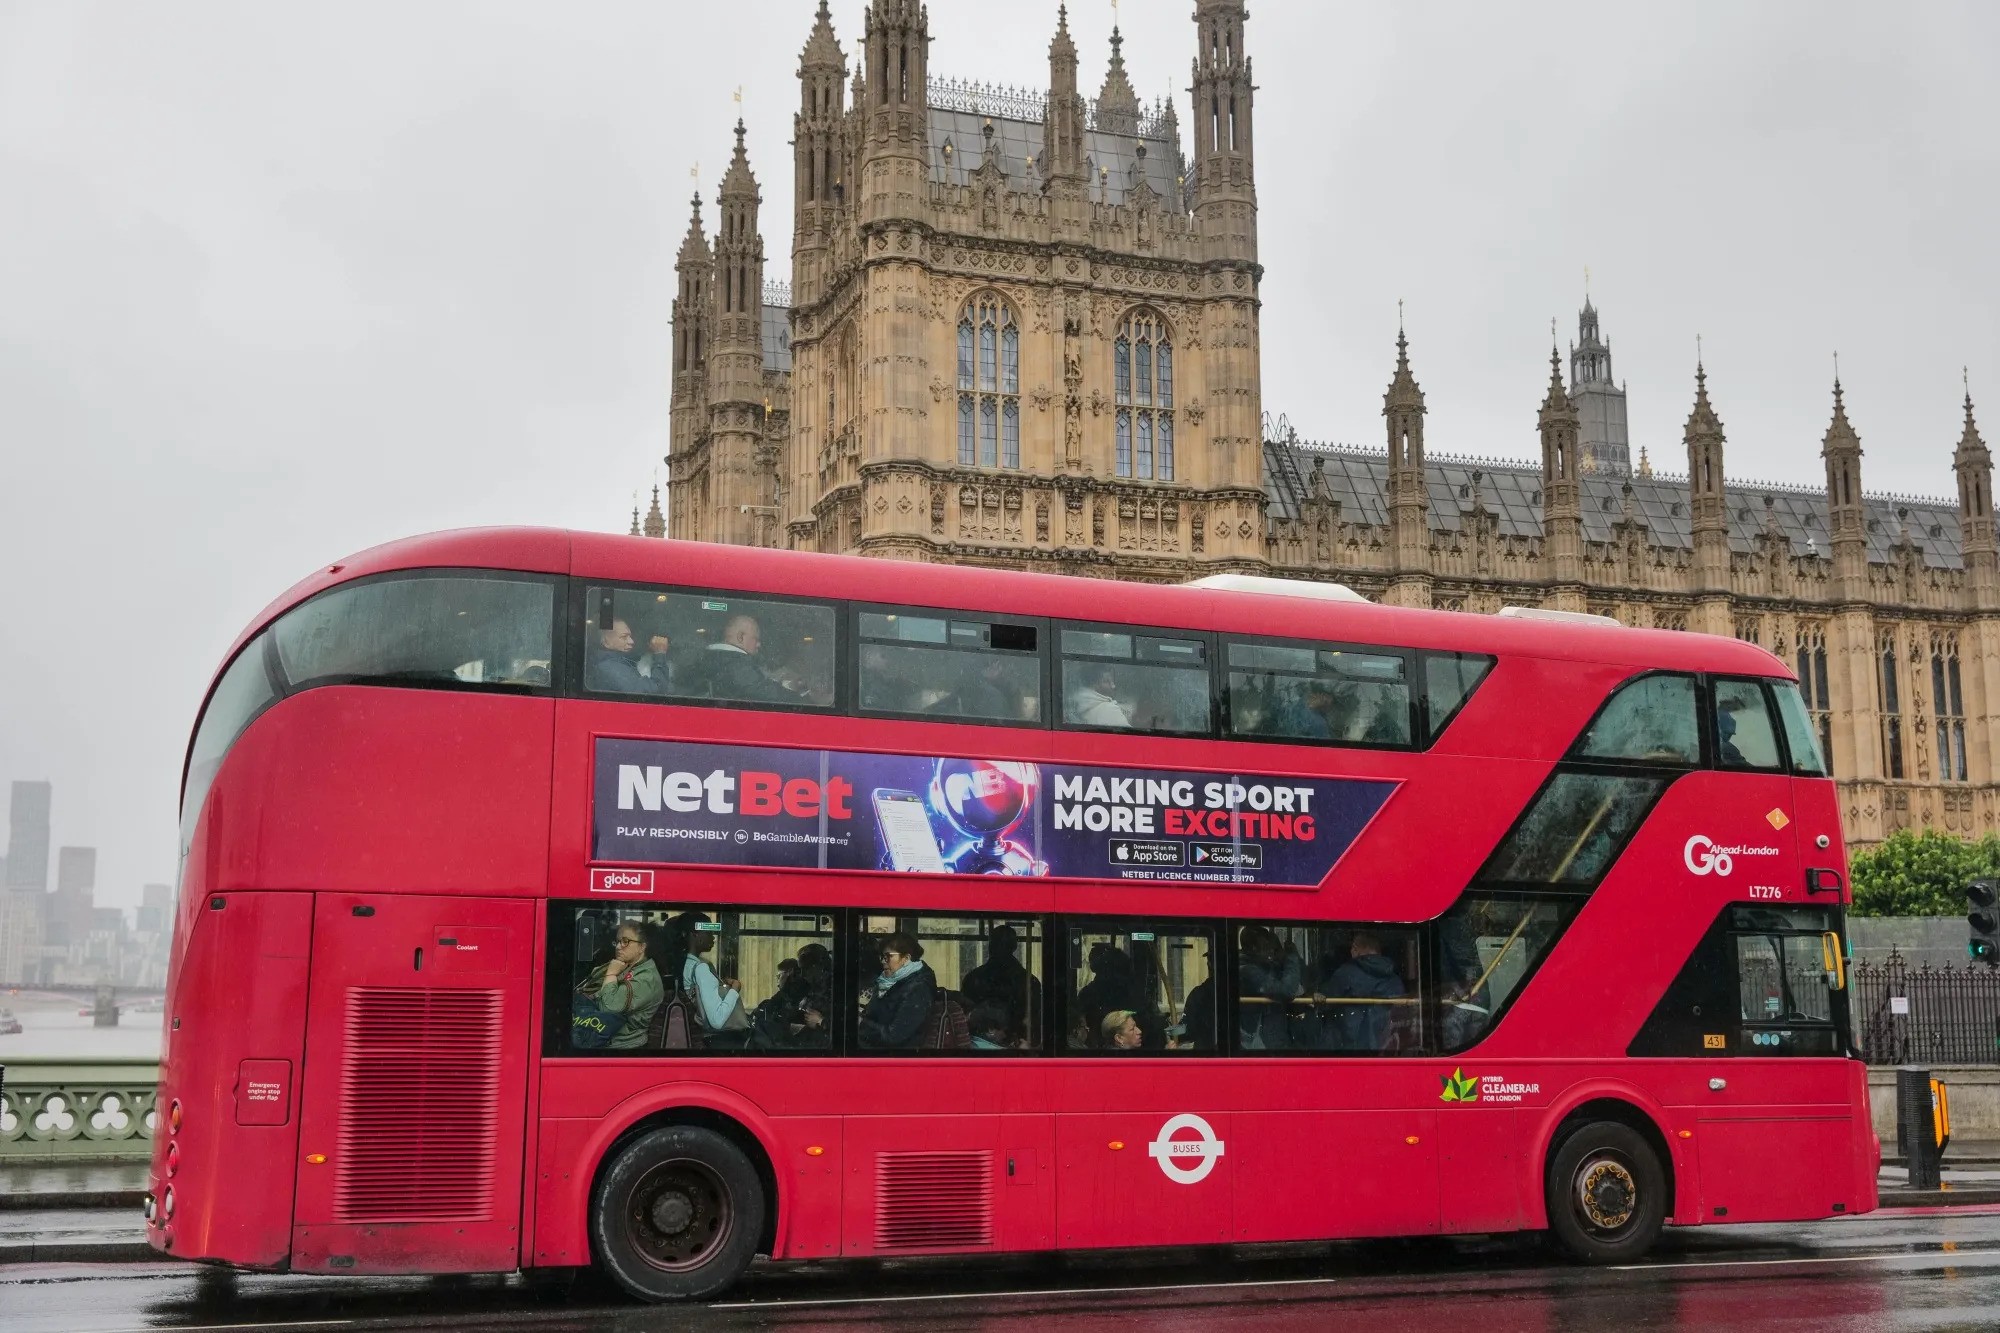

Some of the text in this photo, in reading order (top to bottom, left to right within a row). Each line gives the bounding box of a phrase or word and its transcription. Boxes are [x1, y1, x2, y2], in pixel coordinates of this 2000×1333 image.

[1054, 774, 1314, 813] MAKING SPORT
[1054, 803, 1315, 841] MORE EXCITING
[616, 826, 729, 840] PLAY RESPONSIBLY
[1133, 843, 1159, 851] Download
[1709, 844, 1779, 856] Ahead-London
[1133, 850, 1178, 862] App Store
[1211, 853, 1257, 866] Google Play
[1683, 834, 1733, 877] Go
[604, 872, 641, 889] global
[1122, 870, 1155, 879] NETBET
[1156, 871, 1192, 881] LICENCE
[1193, 873, 1230, 882] NUMBER
[1749, 885, 1782, 899] LT276
[249, 1081, 281, 1089] Emergency
[1172, 1144, 1201, 1154] BUSES
